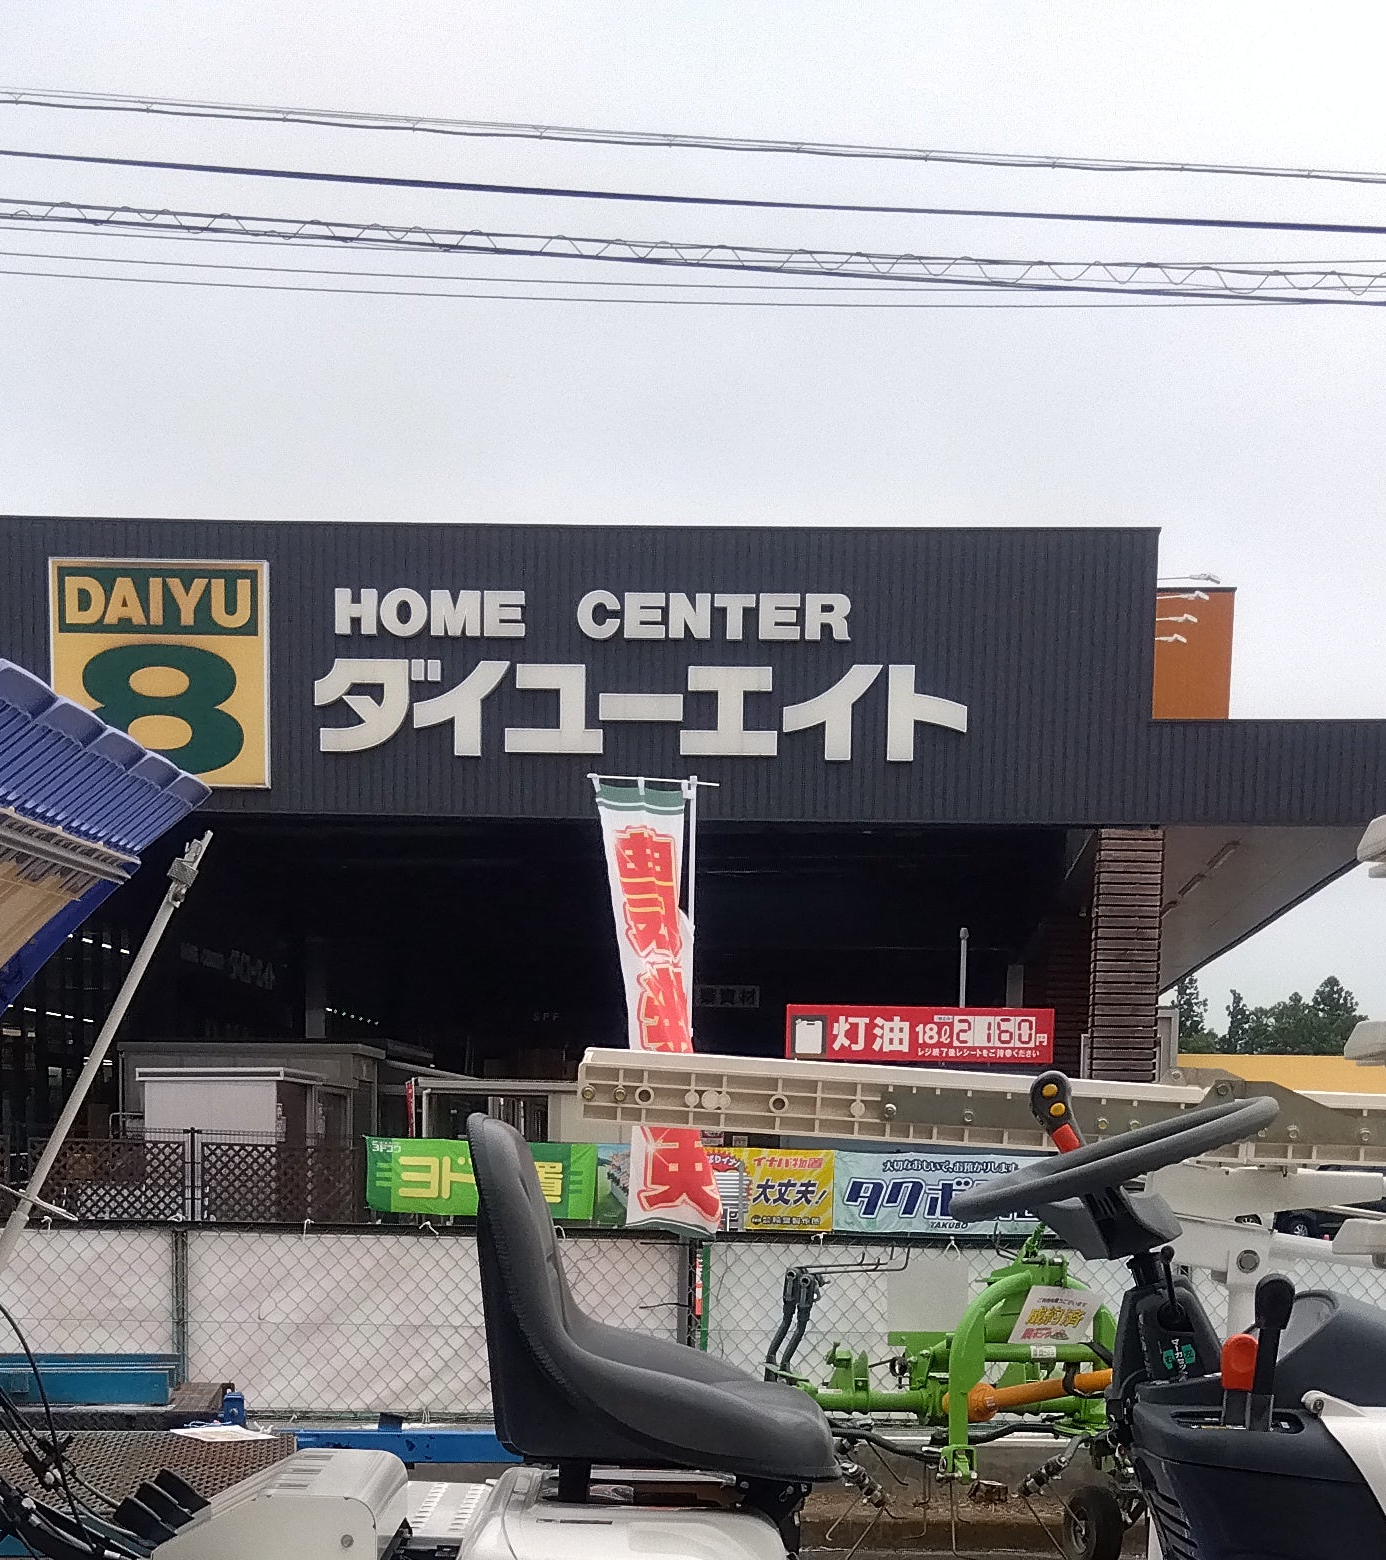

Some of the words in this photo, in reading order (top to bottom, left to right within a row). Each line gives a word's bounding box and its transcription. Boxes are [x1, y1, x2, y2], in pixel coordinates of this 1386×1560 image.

[63, 575, 253, 630] DAIYU
[334, 587, 527, 639] HOME
[577, 590, 851, 643] CENTER
[81, 642, 247, 776] 8
[313, 657, 967, 763] ダイユーエイト
[832, 1015, 910, 1053] 灯油
[930, 1221, 969, 1230] TAKUBO
